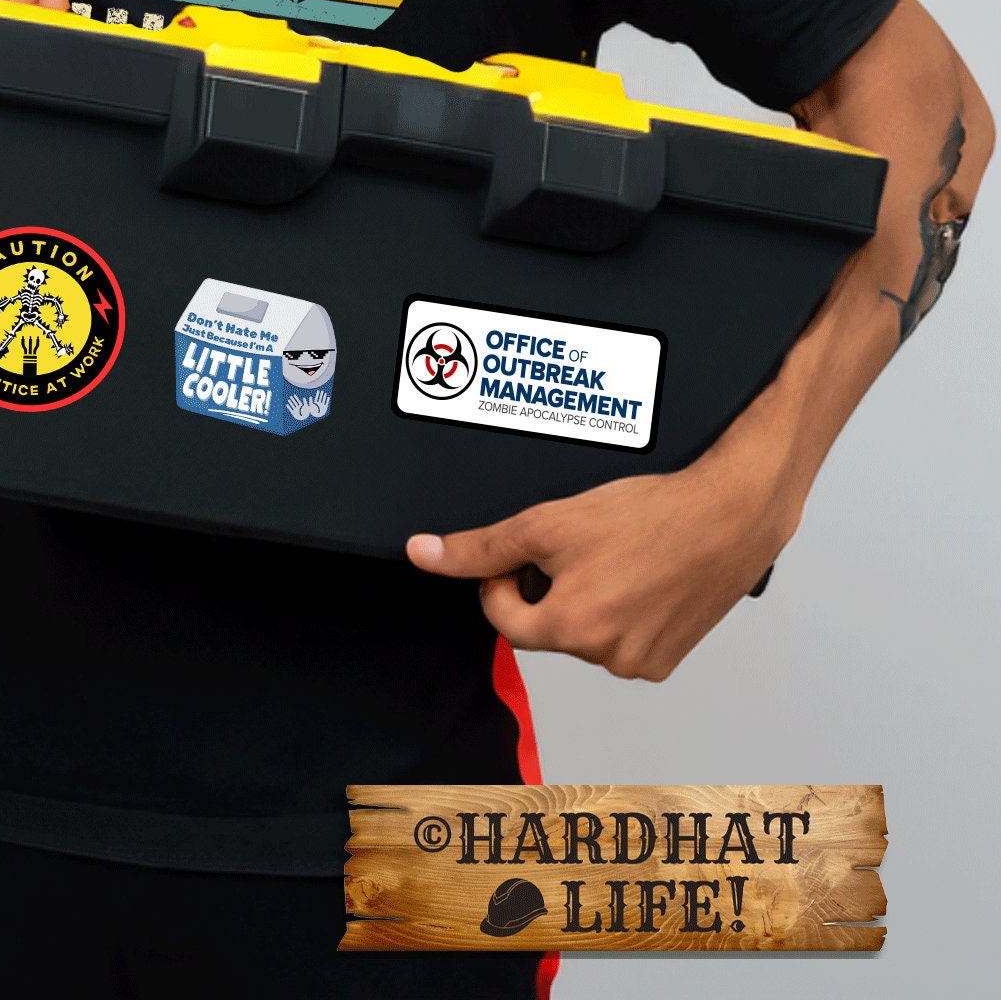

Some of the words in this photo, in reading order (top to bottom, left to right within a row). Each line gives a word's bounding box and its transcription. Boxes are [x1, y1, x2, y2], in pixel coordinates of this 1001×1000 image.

[182, 323, 206, 338] Just
[206, 332, 249, 350] Because
[248, 341, 265, 352] I'm
[265, 344, 274, 353] A
[186, 312, 223, 331] Don't
[225, 322, 258, 339] Hate
[260, 330, 279, 342] Me
[46, 377, 67, 395] AT
[69, 335, 105, 378] WORK
[182, 341, 271, 387] LITTLE
[486, 330, 567, 359] OFFICE
[568, 349, 589, 363] OF
[483, 353, 606, 390] OUTBREAK
[182, 372, 272, 416] COOLER!
[479, 377, 643, 420] MANAGEMENT
[478, 400, 518, 416] ZOMBIE
[519, 406, 587, 427] APOCALYPSE
[588, 417, 639, 434] CONTROL
